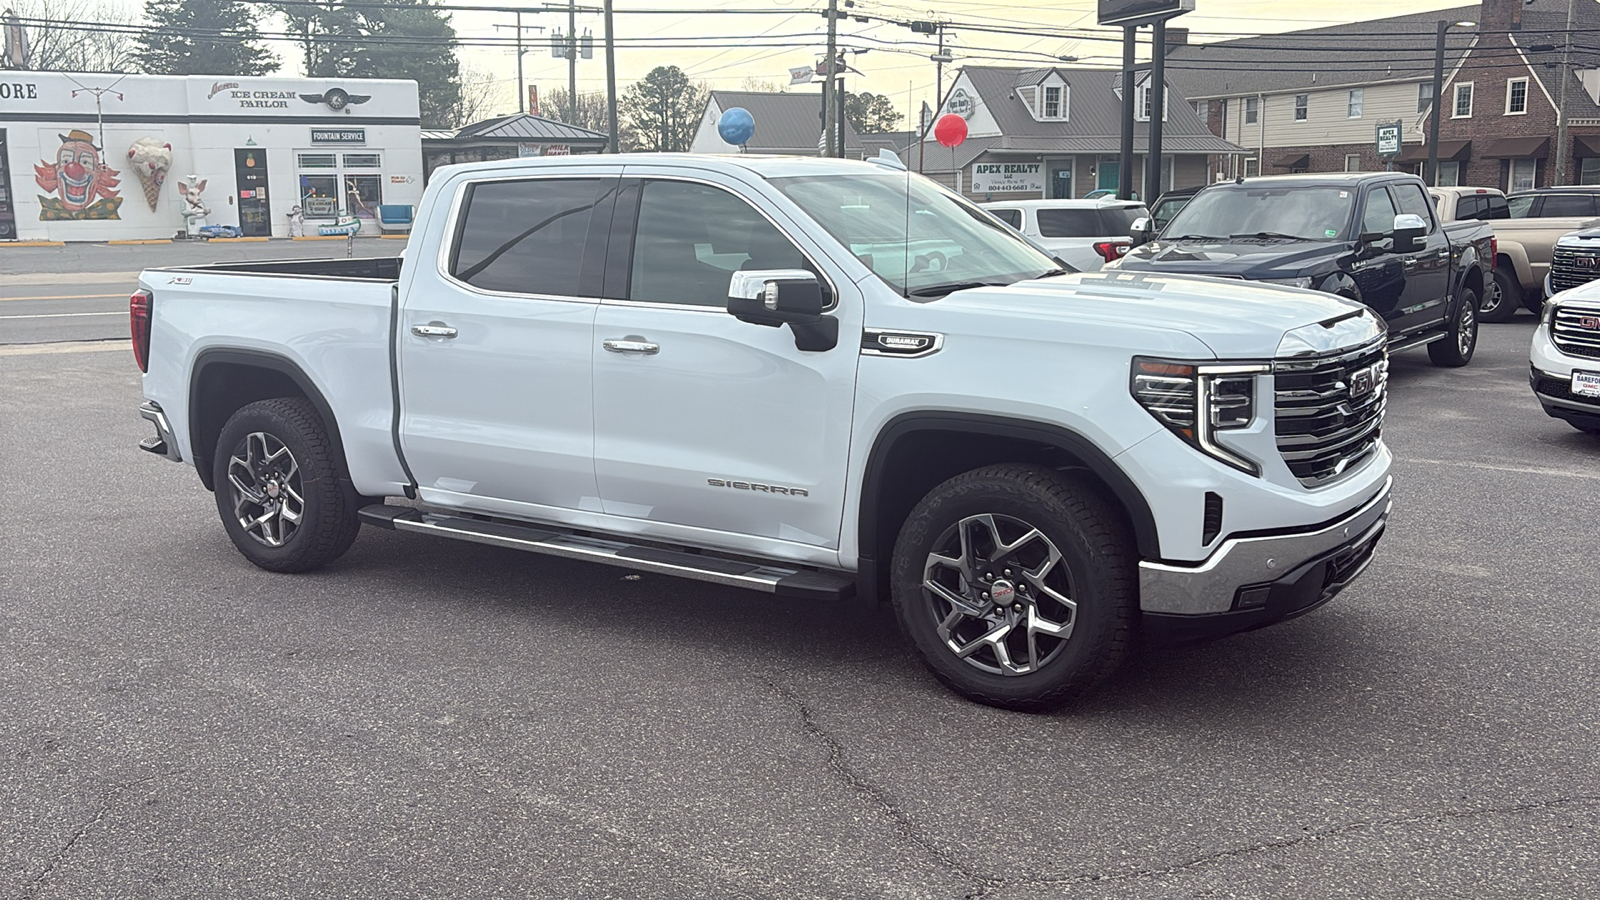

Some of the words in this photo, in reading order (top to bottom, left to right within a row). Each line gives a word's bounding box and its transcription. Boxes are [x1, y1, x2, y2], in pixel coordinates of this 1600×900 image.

[240, 100, 288, 108] PARLOR
[314, 132, 340, 140] FOUNTAIN
[341, 132, 363, 140] SERVICE
[976, 164, 1001, 173] APEX
[1004, 164, 1040, 173] REALTY
[886, 337, 920, 345] DURAMAX
[1577, 375, 1600, 384] BAREFO
[707, 478, 809, 497] SIERRA
